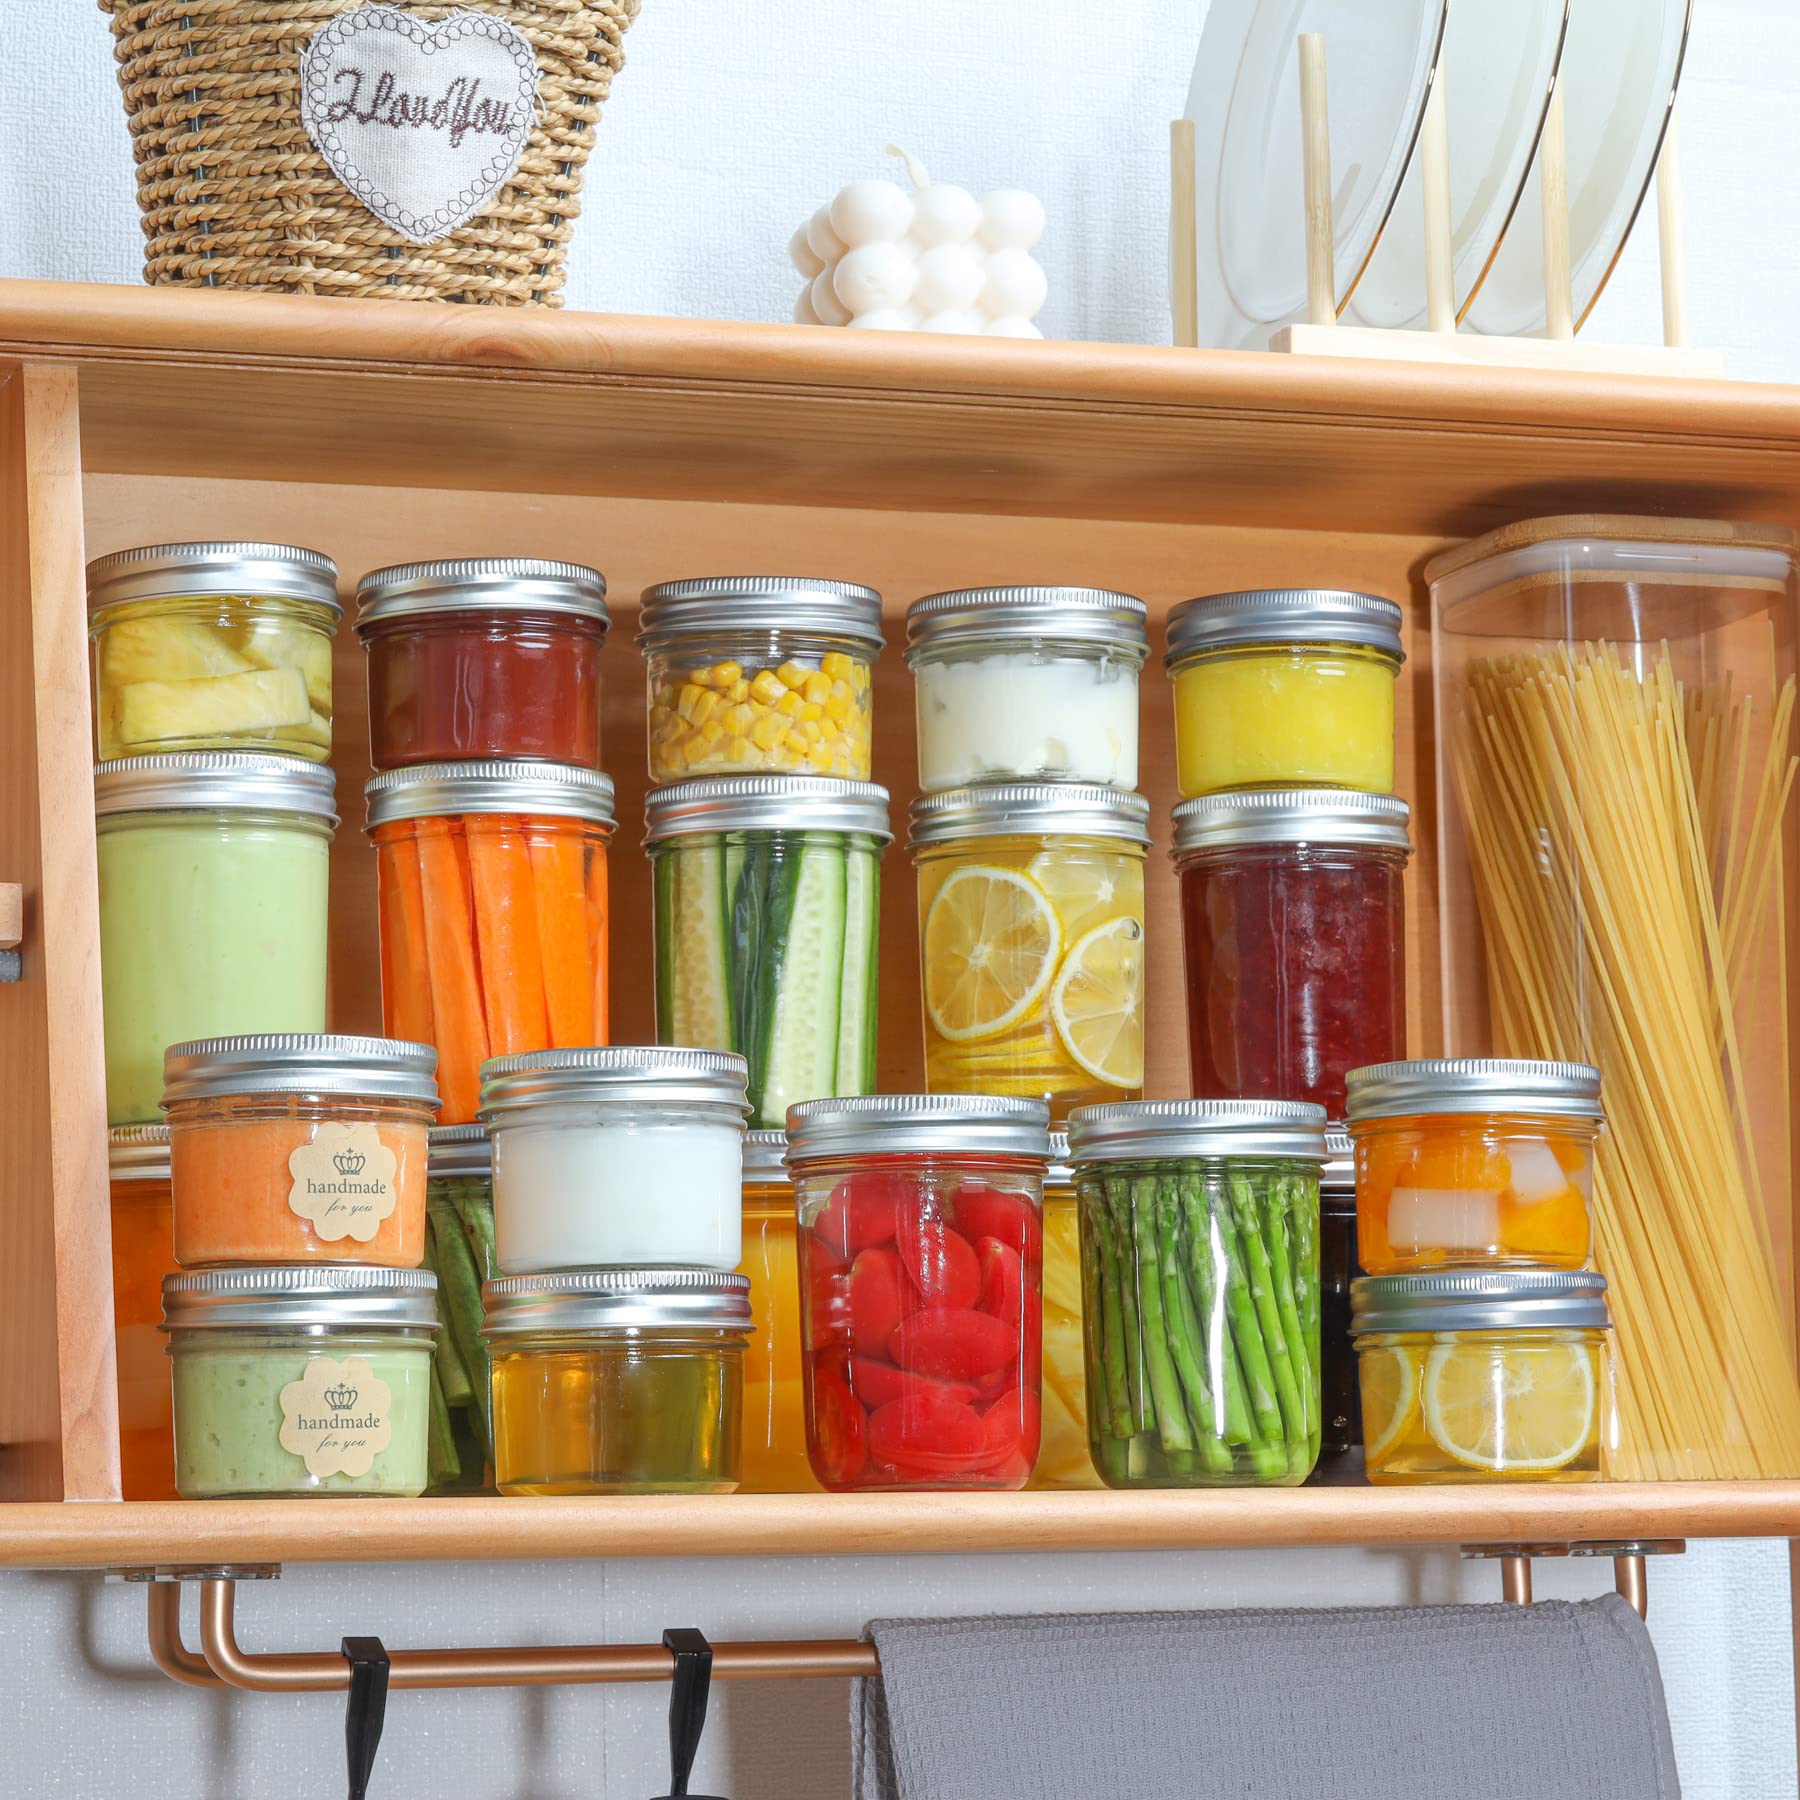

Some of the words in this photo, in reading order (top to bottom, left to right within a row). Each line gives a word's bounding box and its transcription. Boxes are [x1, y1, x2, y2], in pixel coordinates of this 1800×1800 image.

[306, 1178, 386, 1195] handmade
[324, 1197, 348, 1217] for
[348, 1202, 374, 1217] you
[297, 1412, 381, 1430] handmade
[315, 1433, 339, 1453] for
[340, 1439, 368, 1453] you
